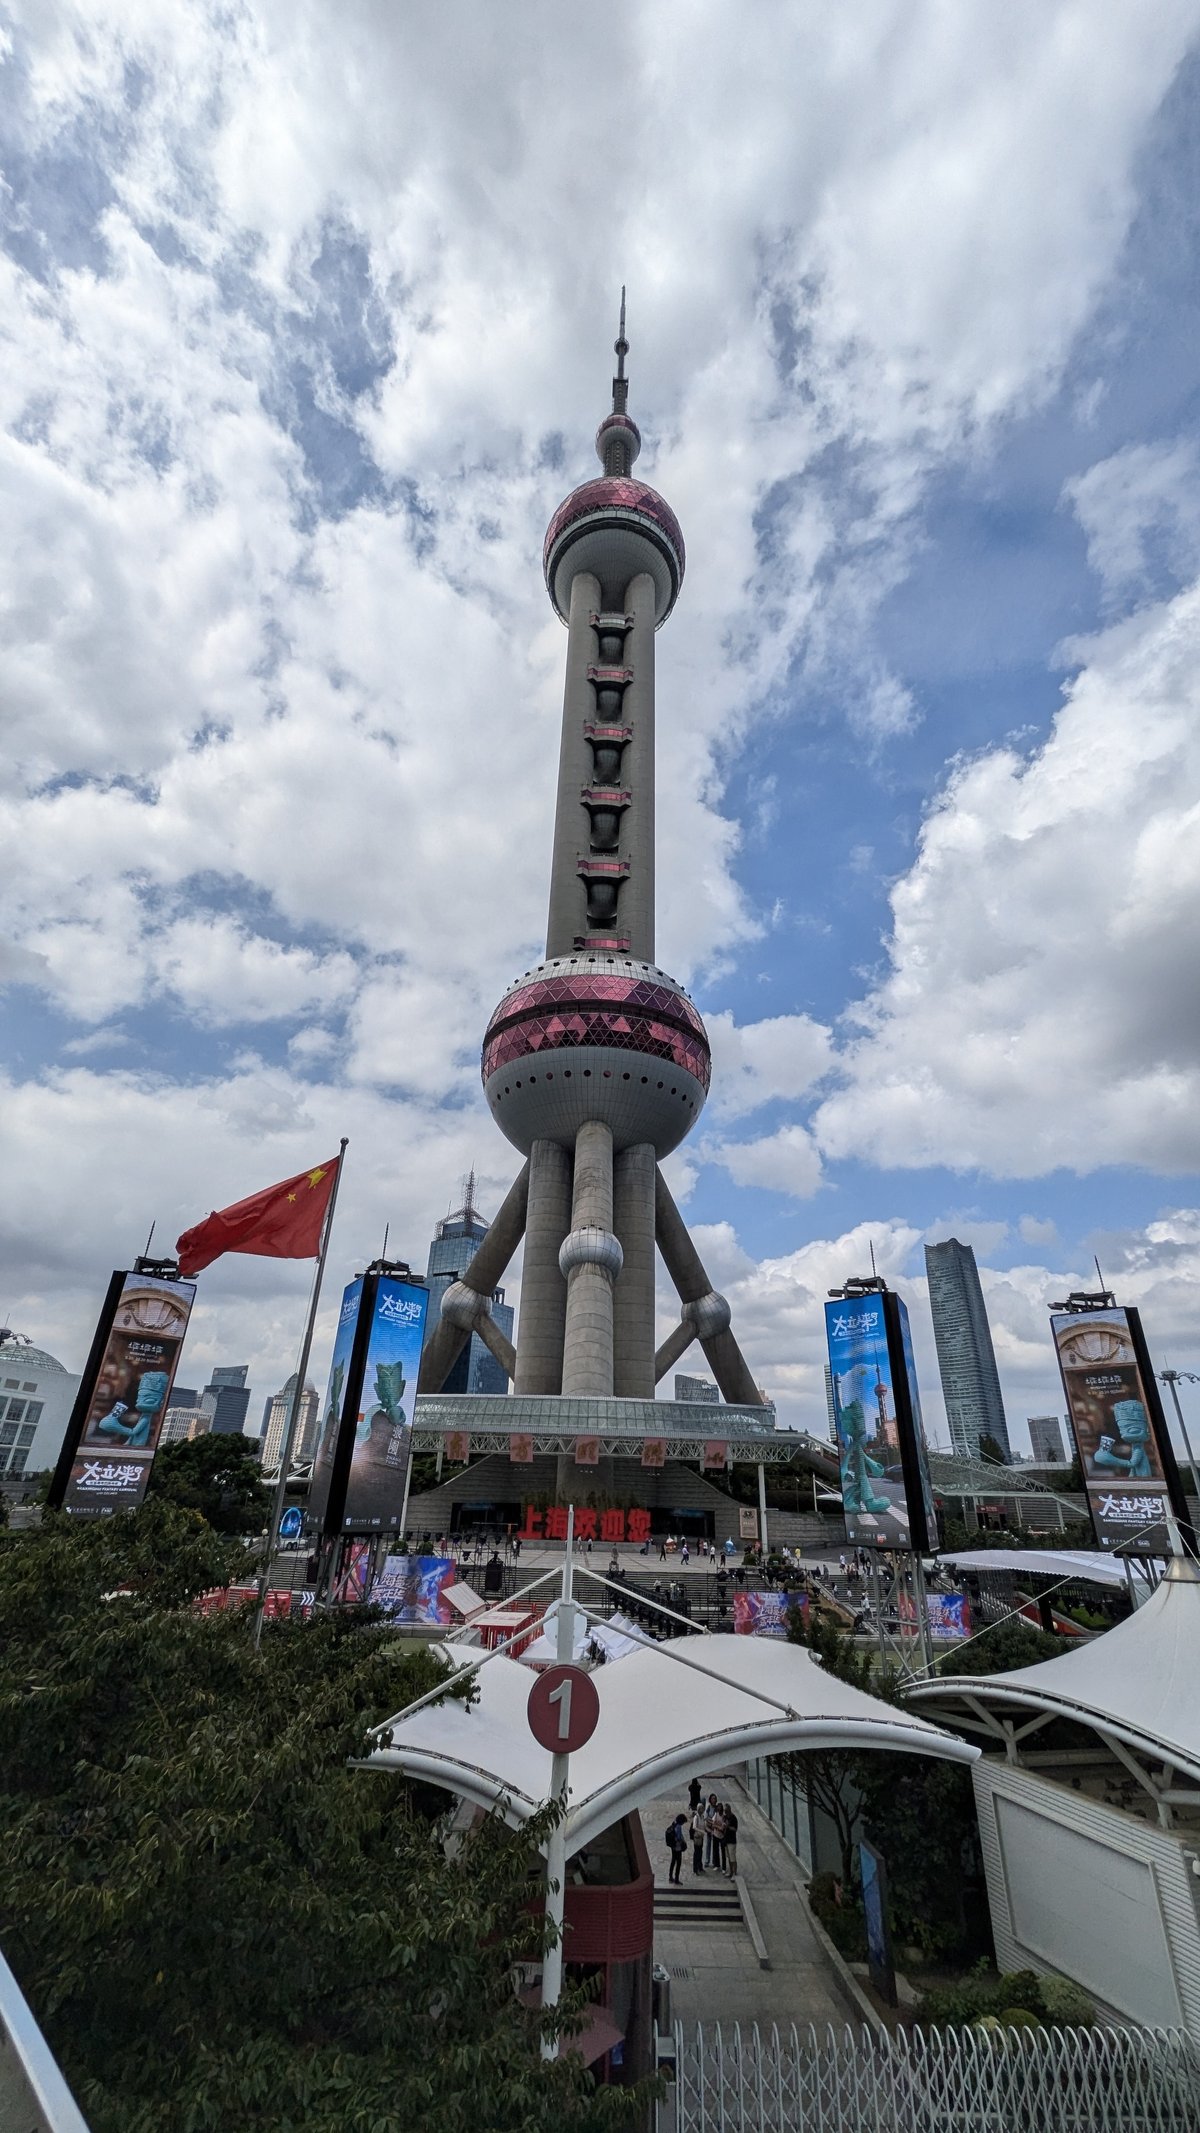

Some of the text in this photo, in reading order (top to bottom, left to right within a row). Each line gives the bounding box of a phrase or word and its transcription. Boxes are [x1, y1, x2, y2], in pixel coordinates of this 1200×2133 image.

[516, 1504, 651, 1542] 上海欢迎您
[548, 1680, 573, 1739] 1
